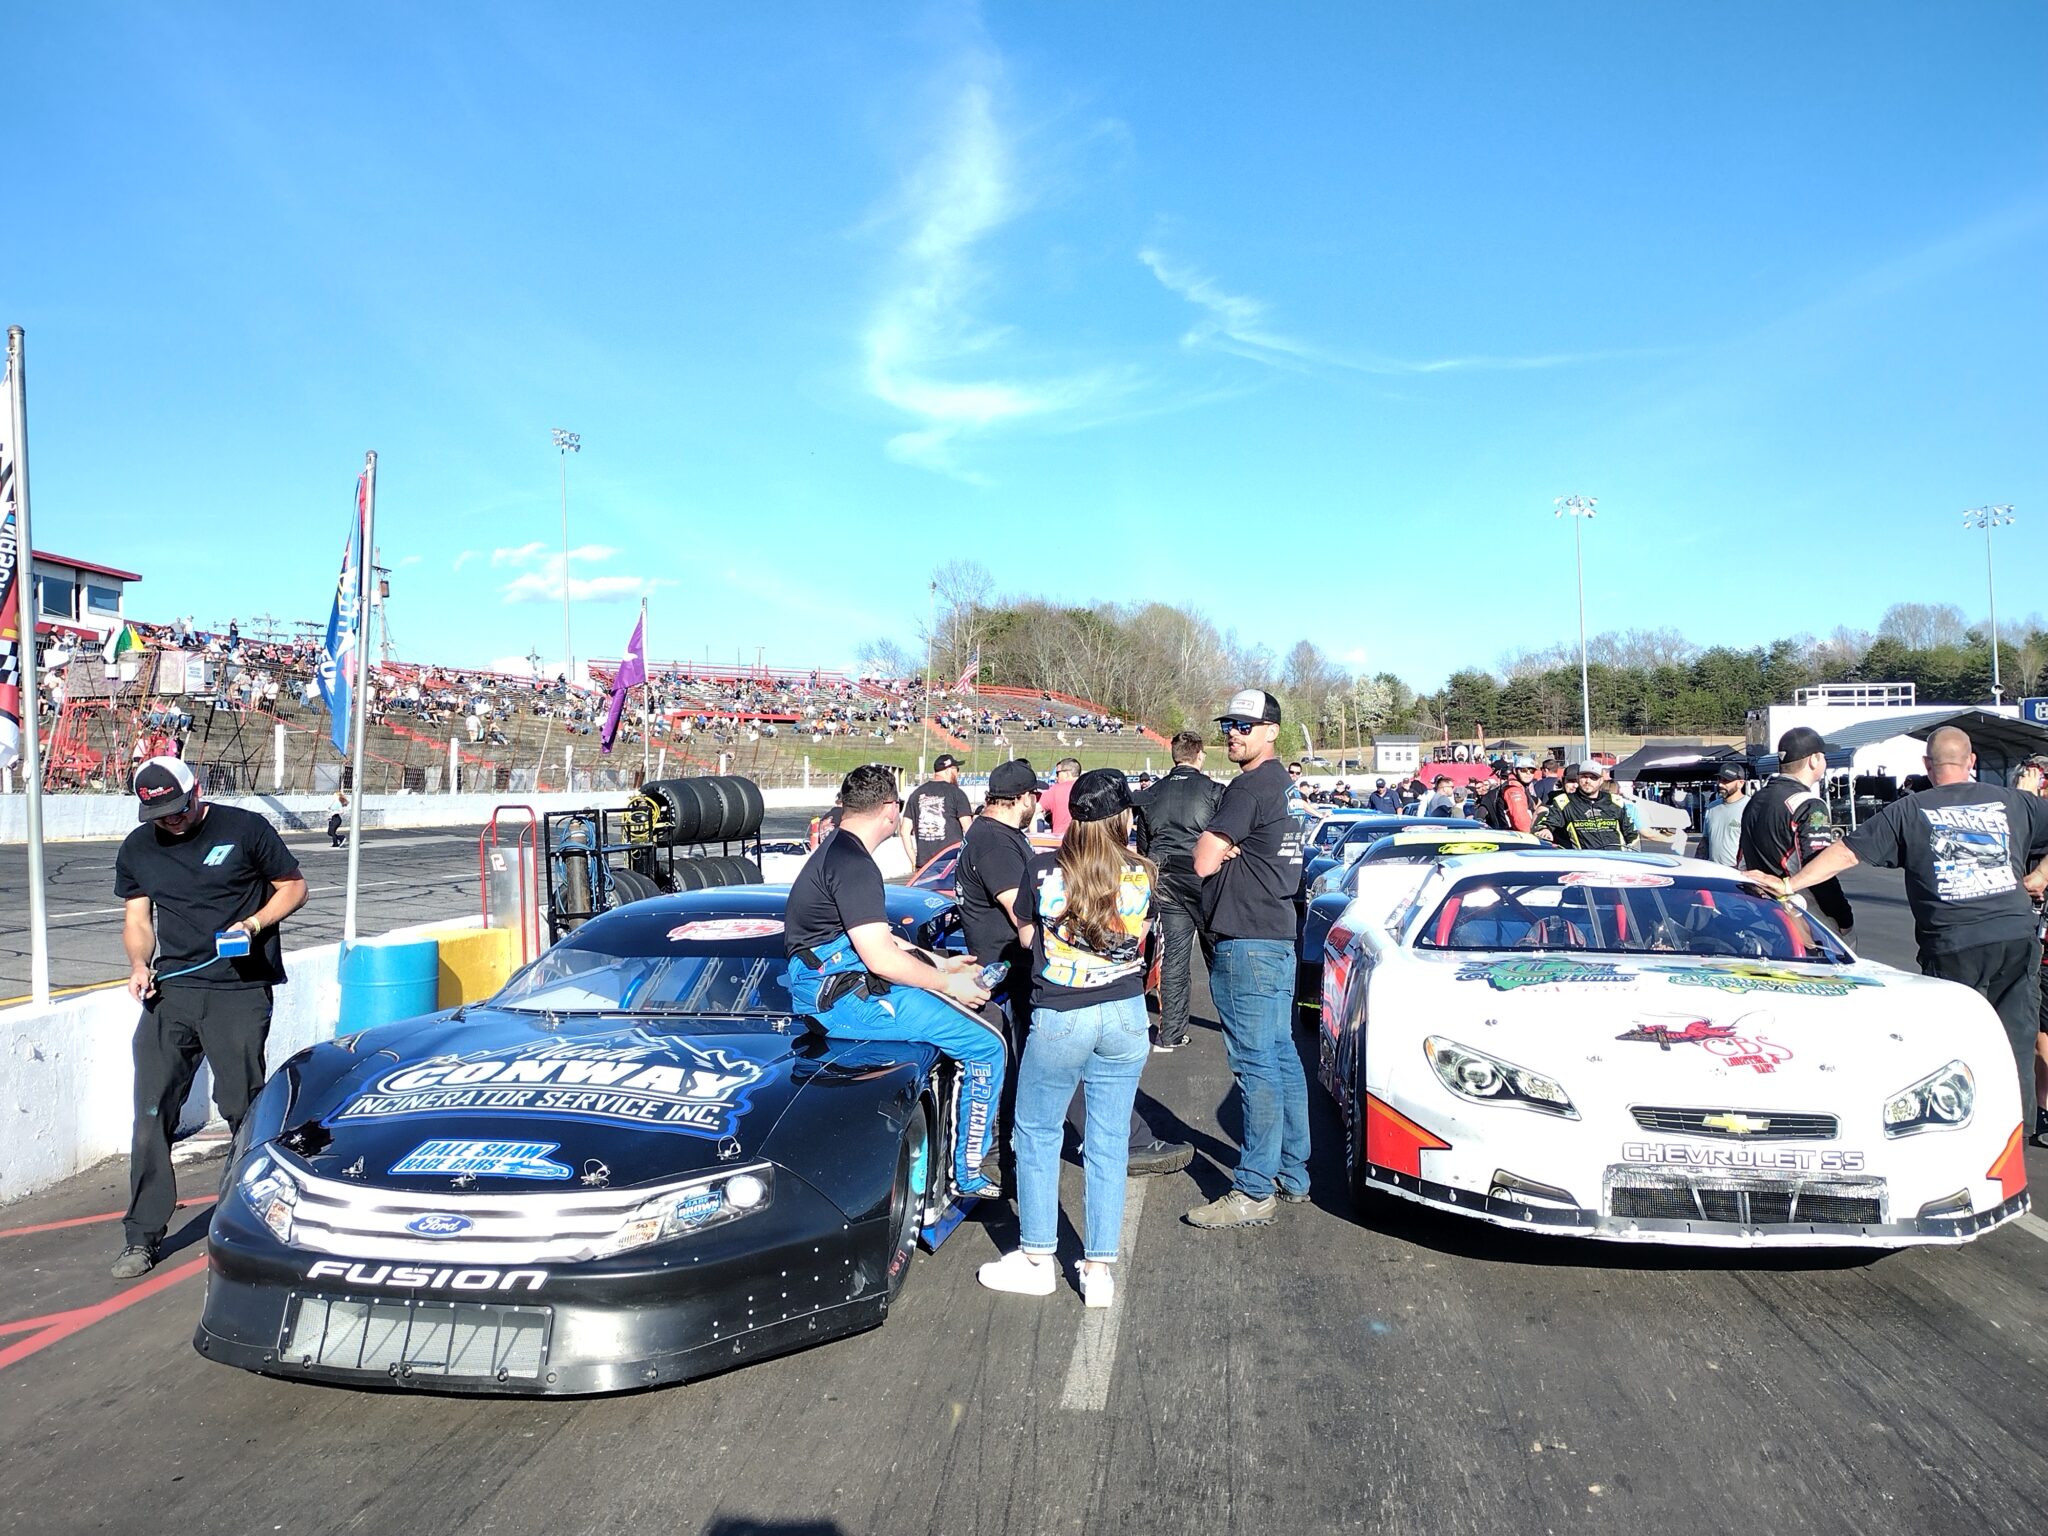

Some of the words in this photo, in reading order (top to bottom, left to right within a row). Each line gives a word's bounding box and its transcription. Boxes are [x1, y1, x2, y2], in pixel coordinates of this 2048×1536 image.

[1920, 808, 2011, 834] BARKER
[516, 1039, 649, 1061] North
[1703, 1036, 1793, 1060] CBS
[390, 1059, 741, 1099] CONWAY
[346, 1091, 536, 1116] INCINERATOR
[536, 1092, 661, 1119] SERVICE
[663, 1104, 722, 1126] INC.
[966, 1101, 989, 1168] EXCAVATION
[417, 1143, 478, 1157] DALE
[476, 1144, 548, 1159] SHAW
[1622, 1142, 1816, 1170] CHEVROLET
[1821, 1150, 1865, 1171] SS
[400, 1158, 445, 1170] RACE
[450, 1159, 500, 1171] CARS
[679, 1199, 720, 1217] BROWN
[418, 1214, 461, 1233] Ford
[307, 1260, 550, 1291] FUSION
